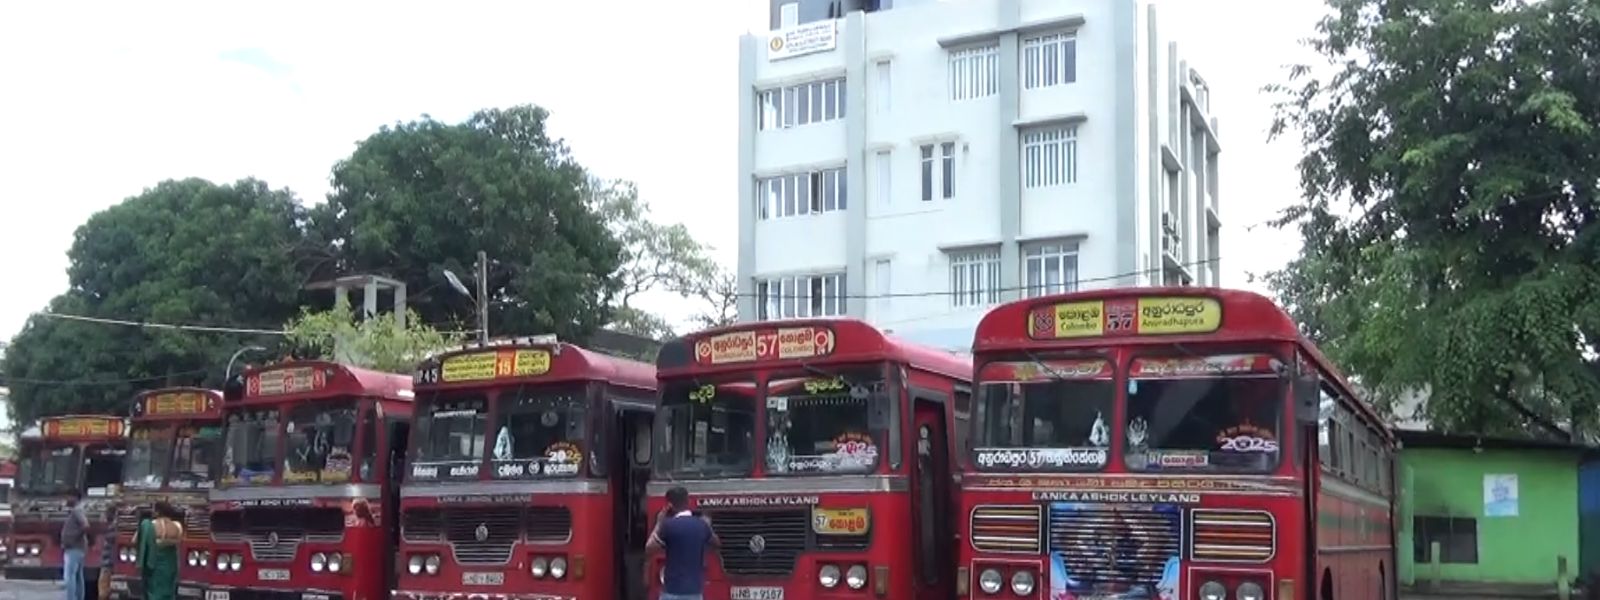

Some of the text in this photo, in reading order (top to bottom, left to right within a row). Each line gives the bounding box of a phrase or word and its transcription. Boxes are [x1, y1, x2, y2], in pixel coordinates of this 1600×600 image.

[1142, 301, 1205, 318] අනුරාධපුර
[1060, 321, 1097, 331] Colombo
[1141, 317, 1204, 328] Anuradhapura
[757, 335, 778, 356] 57
[1221, 435, 1279, 452] 2025
[549, 450, 582, 464] 2025
[978, 451, 1026, 467] අනුරාධපුර
[696, 496, 819, 506] LANKA ASHOK LEYLAND
[1032, 491, 1200, 503] LANKA ASHOK LEYLAND
[815, 515, 827, 527] 57
